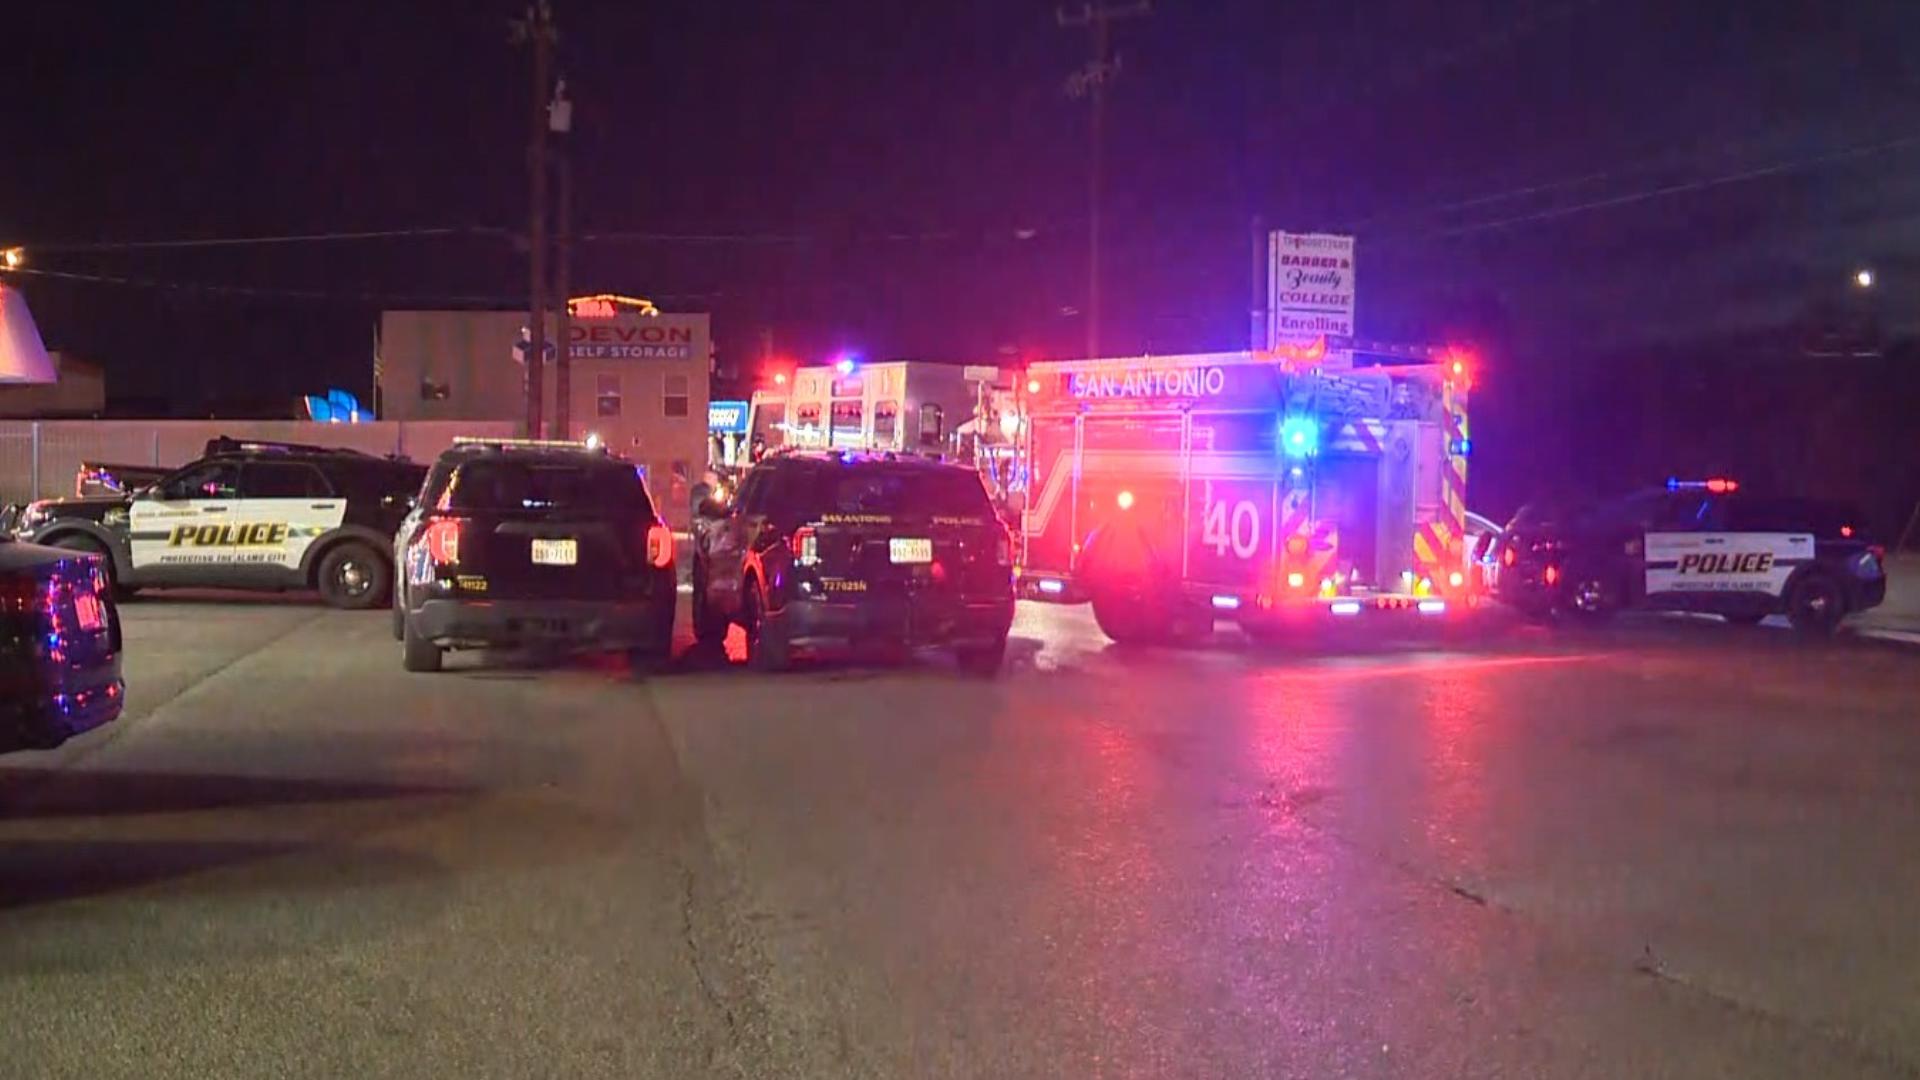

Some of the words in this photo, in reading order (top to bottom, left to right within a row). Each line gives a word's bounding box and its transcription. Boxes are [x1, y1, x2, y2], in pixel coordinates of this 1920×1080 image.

[1281, 255, 1338, 268] BARBER
[1286, 268, 1341, 290] Beauty
[1280, 292, 1350, 305] COLLEGE
[569, 327, 691, 342] DEVON
[1281, 316, 1349, 334] Enrolling
[568, 346, 605, 357] SELF
[611, 346, 689, 358] STORAGE
[1075, 373, 1115, 397] SAN
[1121, 367, 1224, 396] ANTONIO
[171, 523, 287, 547] POLICE
[1202, 499, 1260, 558] 40
[1679, 553, 1773, 574] POLICE
